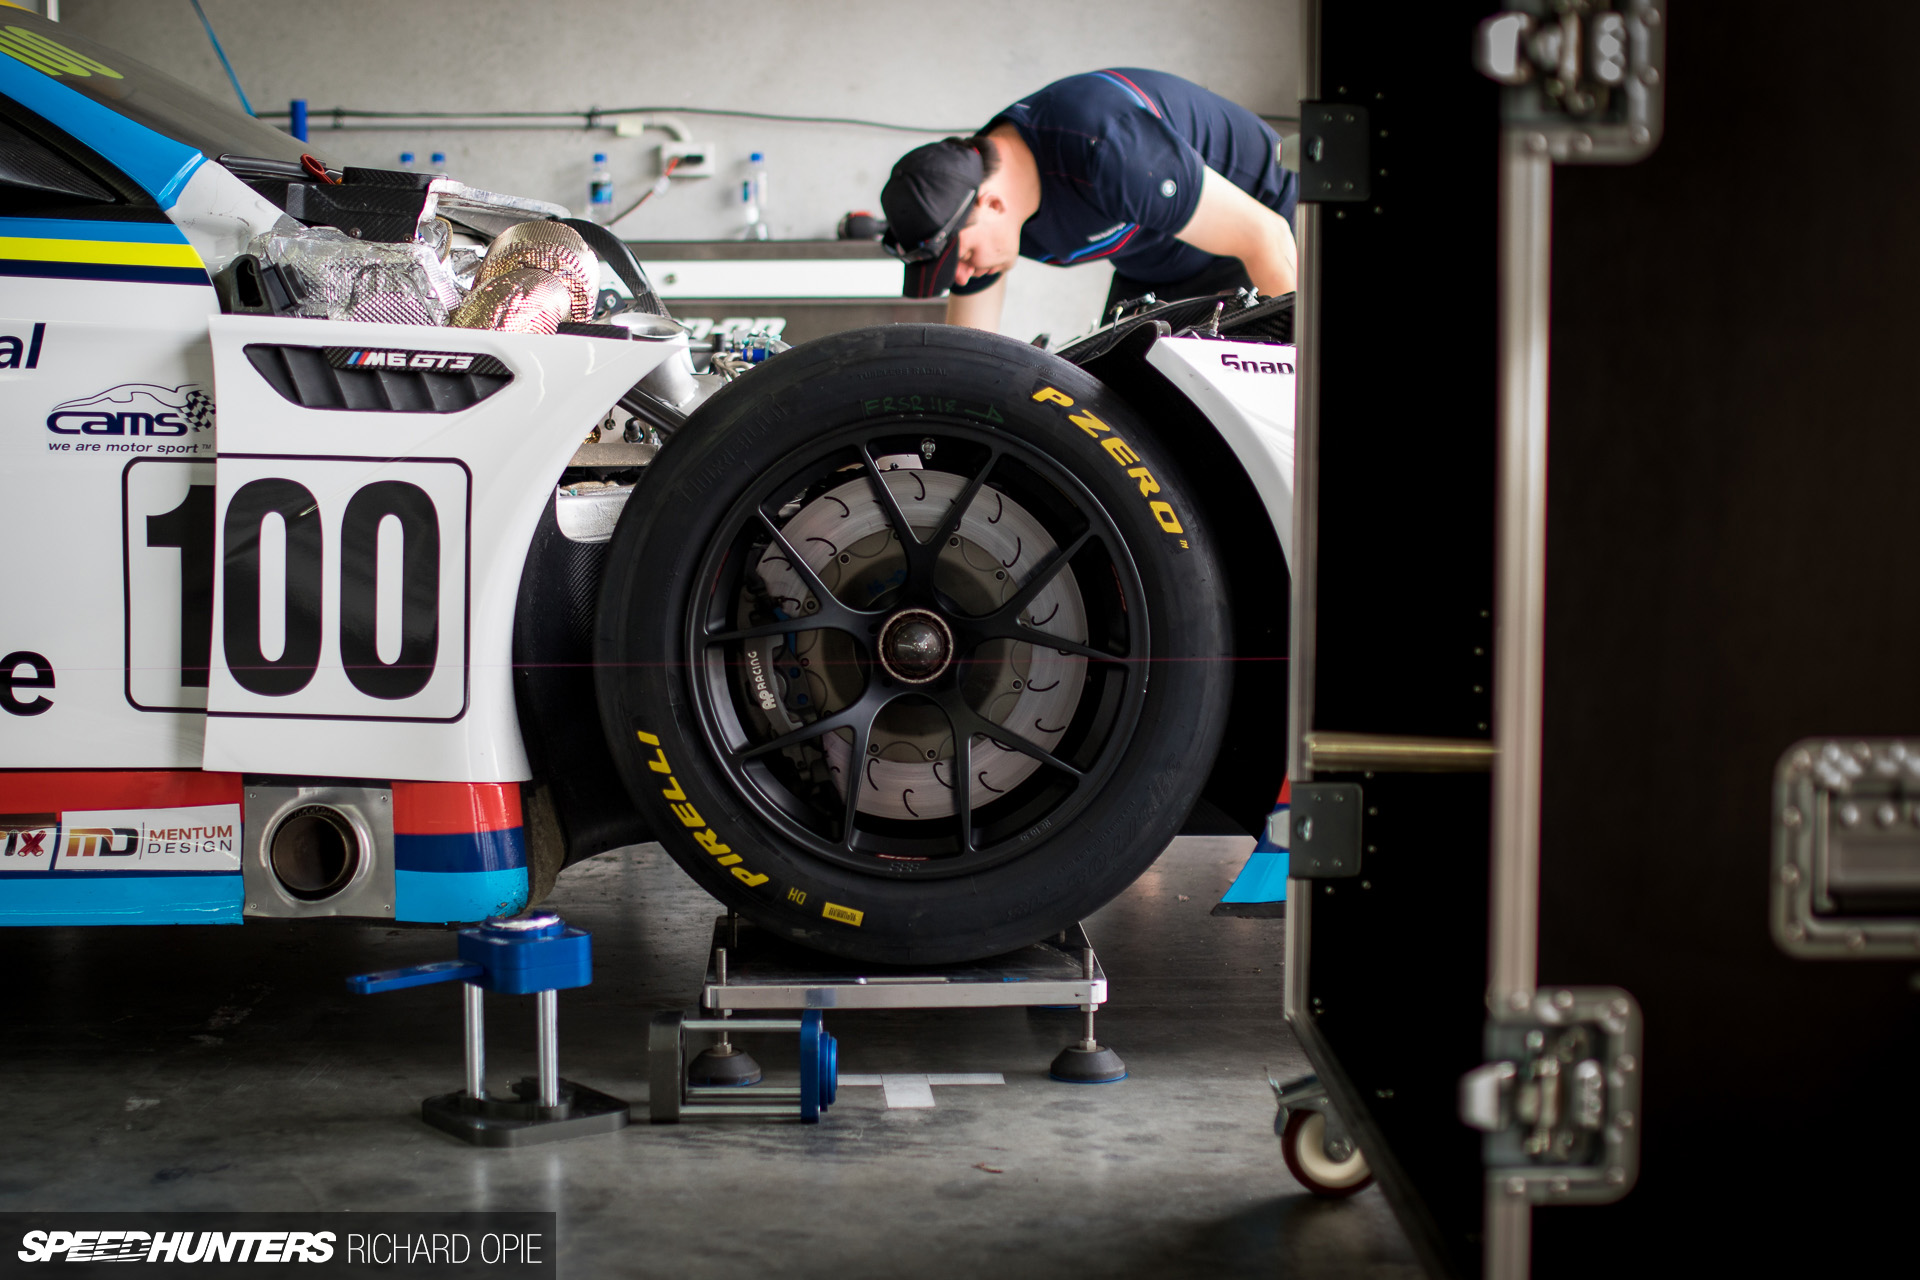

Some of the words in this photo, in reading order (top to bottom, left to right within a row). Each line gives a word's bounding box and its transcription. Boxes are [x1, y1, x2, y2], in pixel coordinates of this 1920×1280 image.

[363, 352, 407, 366] M6
[409, 354, 474, 369] GT3
[48, 442, 71, 451] we
[75, 442, 101, 452] are
[106, 442, 153, 453] motor
[156, 443, 199, 455] sport
[147, 477, 440, 700] 100
[0, 650, 56, 717] e
[747, 650, 767, 691] RACING
[637, 730, 770, 887] PIRELLI
[149, 824, 233, 842] MENTUM
[787, 887, 807, 905] DH
